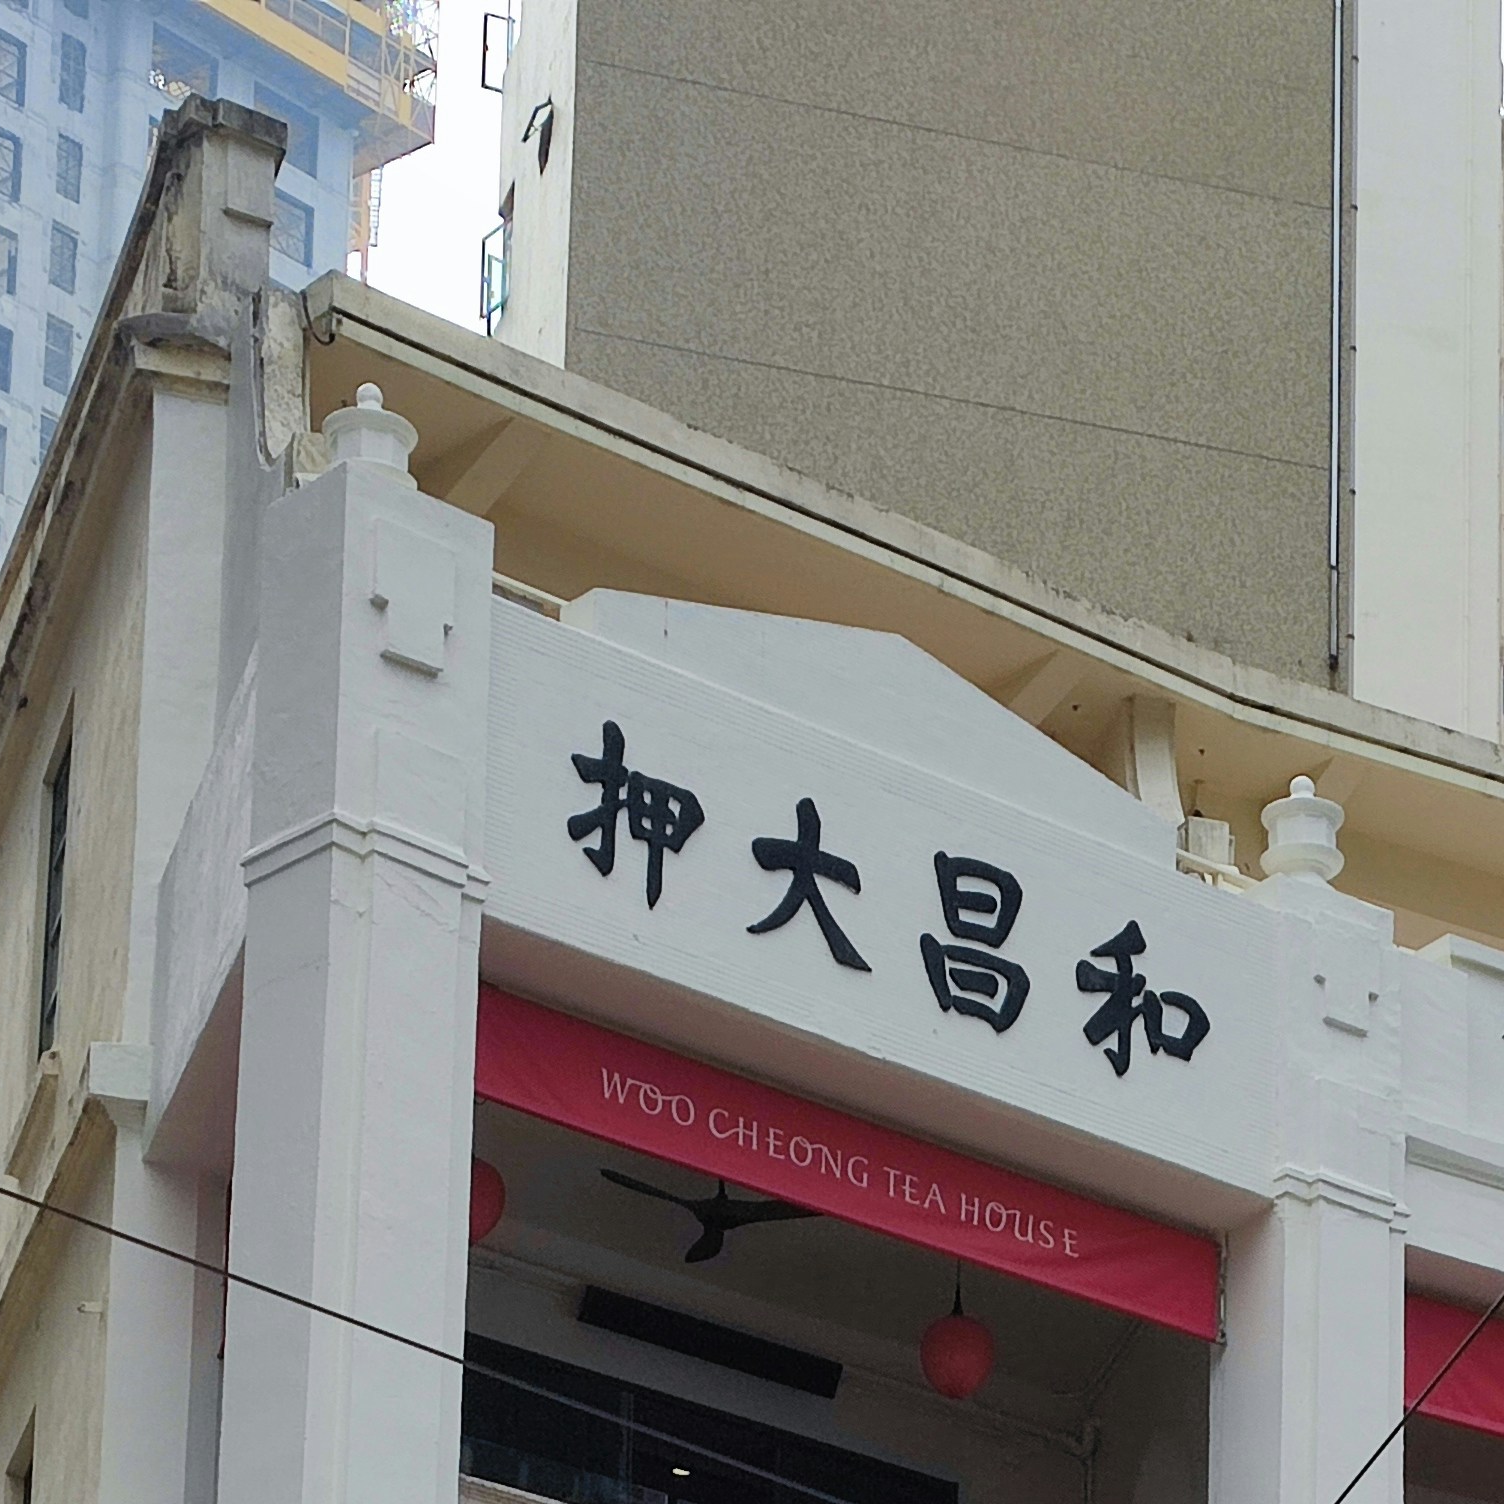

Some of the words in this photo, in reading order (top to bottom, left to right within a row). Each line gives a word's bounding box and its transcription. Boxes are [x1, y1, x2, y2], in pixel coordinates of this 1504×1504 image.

[601, 1066, 695, 1127] WOO
[708, 1108, 870, 1188] CHEONG
[883, 1166, 947, 1215] TEA
[959, 1193, 1080, 1259] HOUSE
